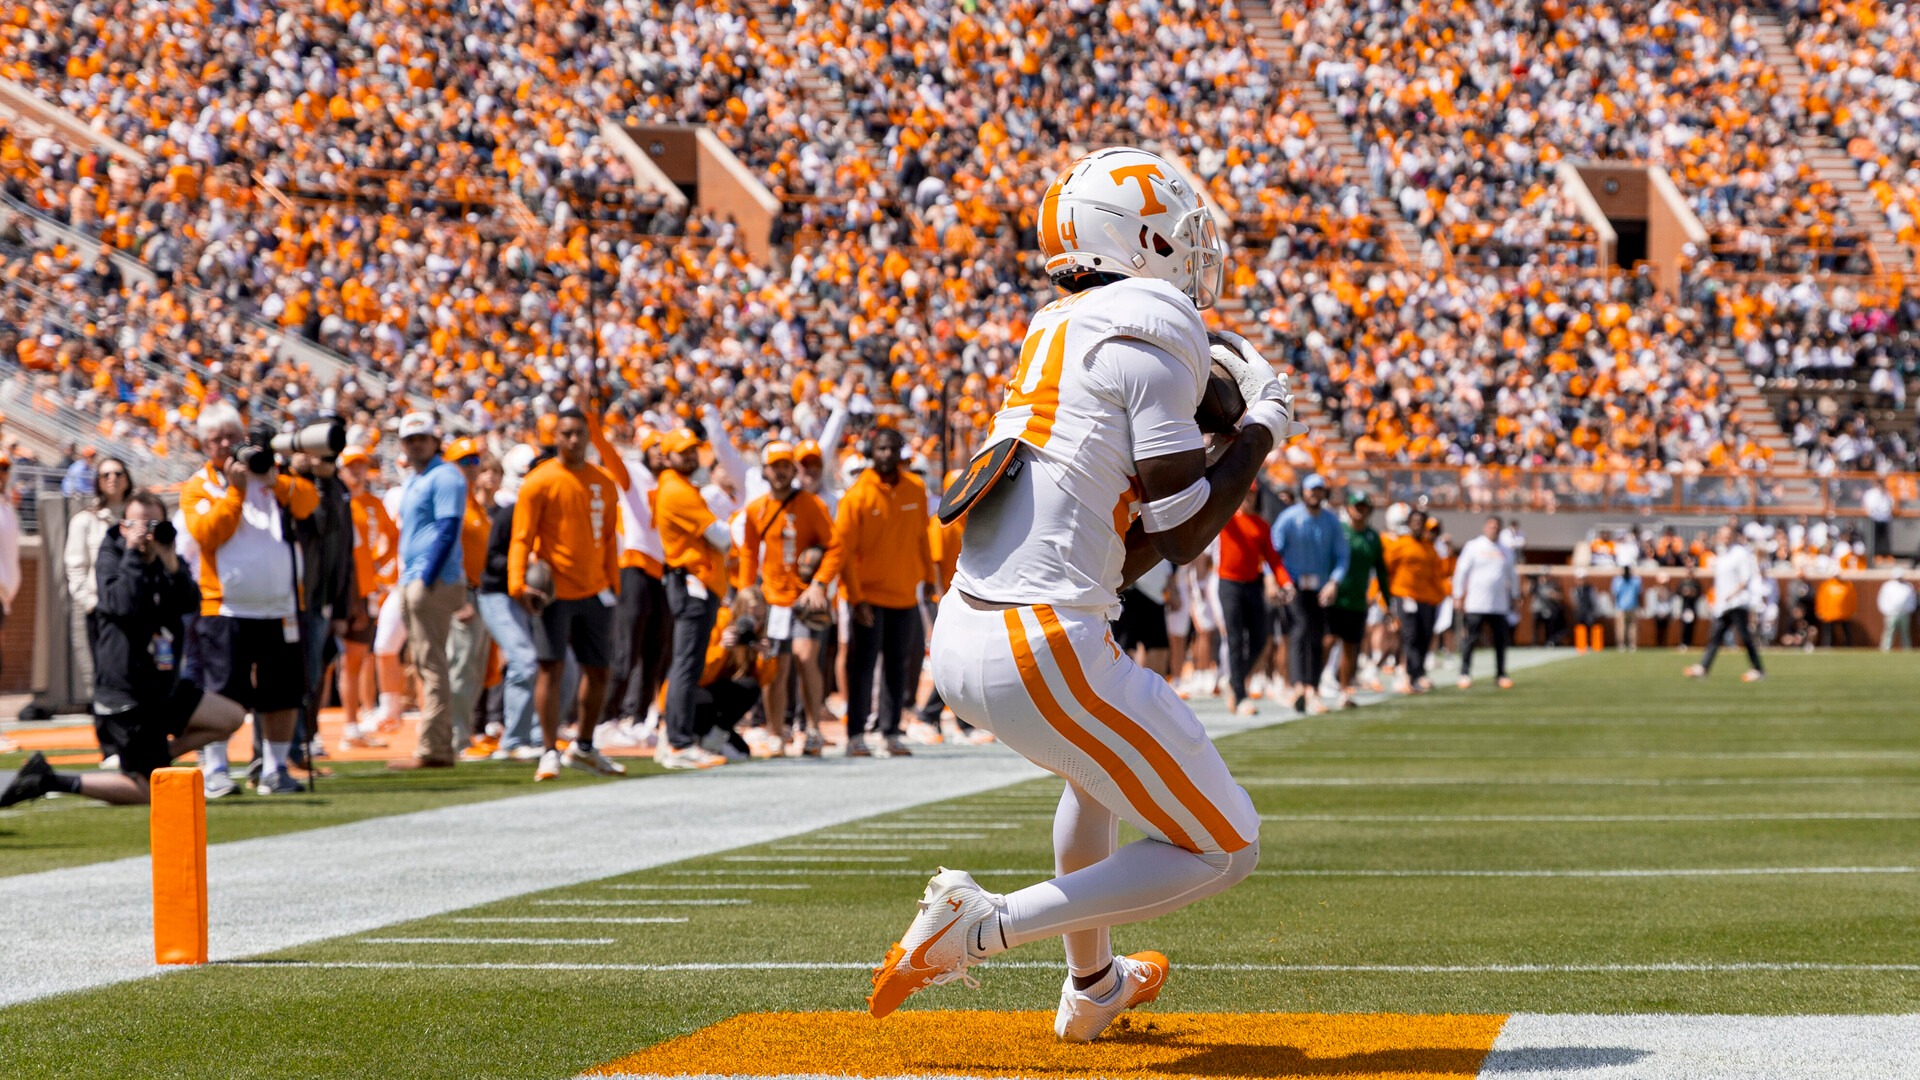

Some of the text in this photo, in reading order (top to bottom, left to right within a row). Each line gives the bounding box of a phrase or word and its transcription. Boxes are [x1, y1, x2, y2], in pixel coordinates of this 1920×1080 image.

[1109, 163, 1167, 217] T
[1061, 221, 1078, 250] 4
[949, 449, 995, 506] T
[946, 896, 963, 913] T
